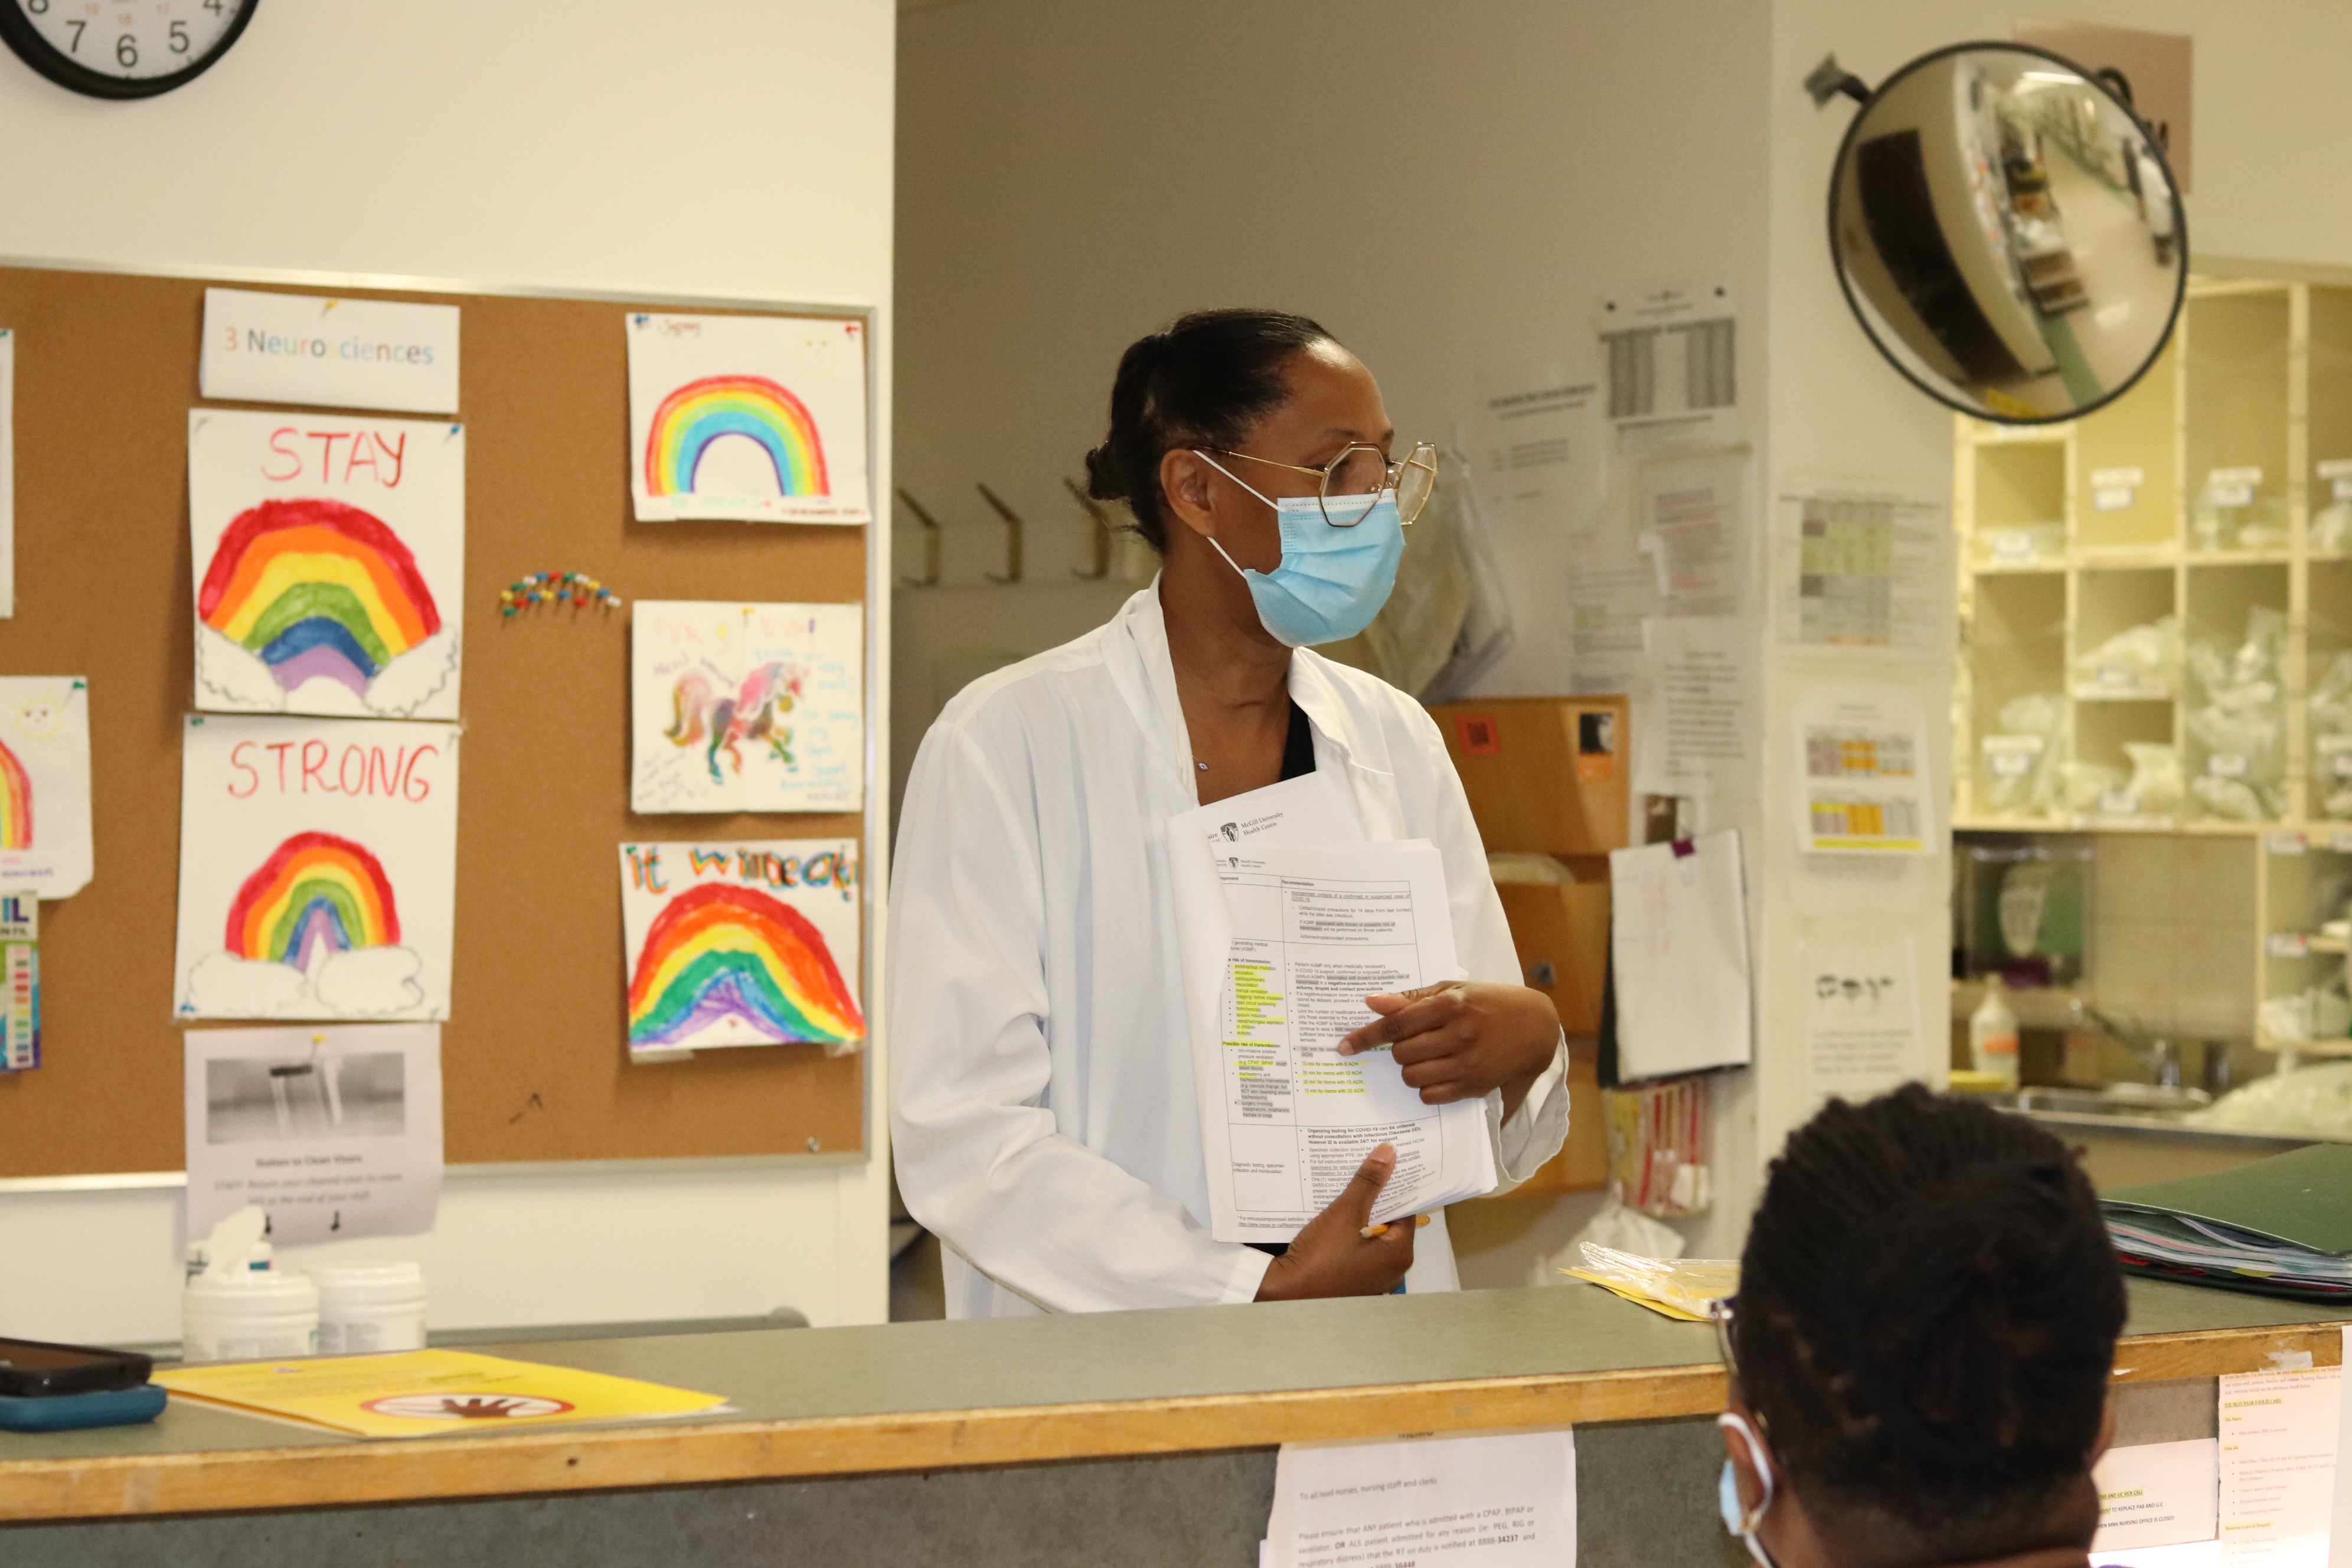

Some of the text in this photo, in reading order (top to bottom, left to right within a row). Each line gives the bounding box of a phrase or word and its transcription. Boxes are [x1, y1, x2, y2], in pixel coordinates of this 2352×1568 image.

[66, 19, 87, 53] 7
[117, 34, 138, 68] 6
[168, 21, 190, 54] 5
[224, 326, 435, 365] 3 Neurosciences
[260, 427, 406, 489] STAY
[227, 739, 439, 803] STRONG
[1241, 812, 1283, 828] McGill University
[1243, 821, 1278, 836] Health Centre
[1300, 1492, 1309, 1500] To
[1319, 1488, 1334, 1498] head
[1335, 1487, 1359, 1496] nurses,
[1361, 1484, 1385, 1494] nursing
[1387, 1480, 1402, 1489] staff
[1403, 1479, 1417, 1488] and
[1419, 1477, 1437, 1486] clerks
[1298, 1532, 1319, 1540] Please
[1321, 1528, 1344, 1537] ensure
[1346, 1526, 1361, 1535] that
[1363, 1524, 1377, 1533] ANY
[1378, 1521, 1402, 1531] patient
[1404, 1518, 1420, 1527] who
[1428, 1514, 1457, 1524] admitted
[1459, 1511, 1475, 1520] with
[1483, 1508, 1503, 1518] CPAP,
[1505, 1506, 1525, 1515] BIPAP
[1298, 1544, 1332, 1554] ventilator,
[1335, 1541, 1345, 1549] OR
[1365, 1537, 1388, 1547] patient
[1391, 1532, 1423, 1543] admitted
[1438, 1528, 1450, 1538] any
[1453, 1525, 1475, 1534] reason
[1493, 1522, 1509, 1530] PEG,
[1513, 1520, 1524, 1528] RIG
[1298, 1558, 1334, 1568] respiratory
[1336, 1554, 1365, 1564] distress)
[1367, 1551, 1381, 1560] that
[1383, 1549, 1393, 1558] the
[1396, 1547, 1405, 1556] RT
[1407, 1547, 1416, 1555] on
[1417, 1543, 1432, 1554] duty
[1440, 1540, 1466, 1550] notified
[1468, 1538, 1476, 1547] at
[1523, 1531, 1535, 1541] and
